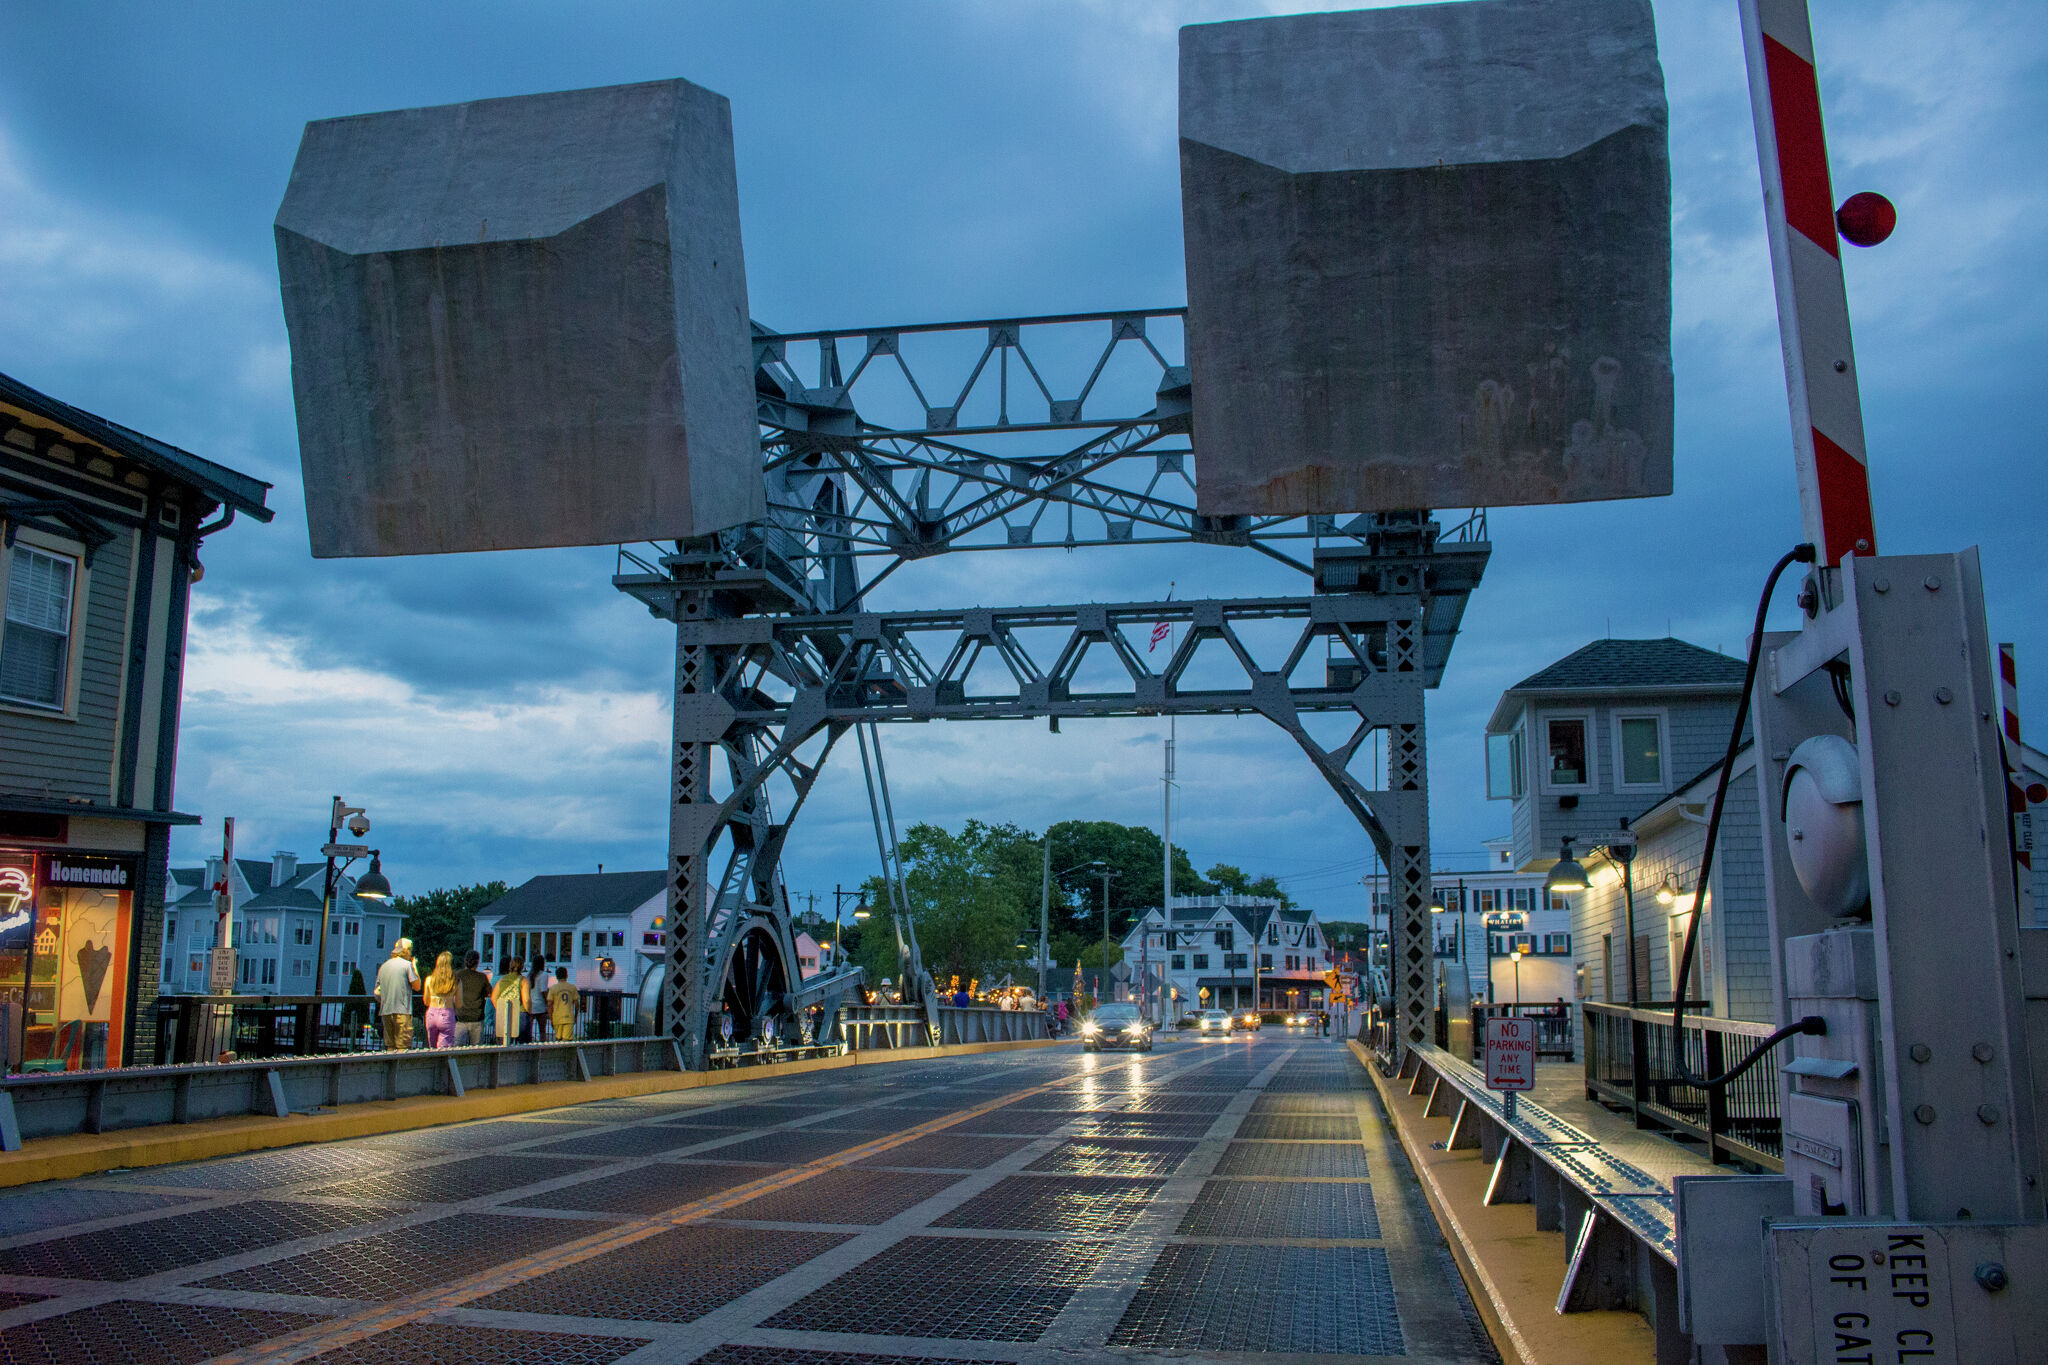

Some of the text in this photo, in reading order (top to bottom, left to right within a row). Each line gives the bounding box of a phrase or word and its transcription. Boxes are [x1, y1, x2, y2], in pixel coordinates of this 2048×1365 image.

[51, 860, 127, 884] Homemade
[562, 992, 569, 1005] 9
[1501, 1023, 1519, 1038] NO
[1489, 1039, 1531, 1051] PARKING
[1501, 1053, 1520, 1063] ANY
[1498, 1064, 1521, 1074] TIME
[1828, 1254, 1868, 1291] OF
[1887, 1234, 1930, 1308] KEEP
